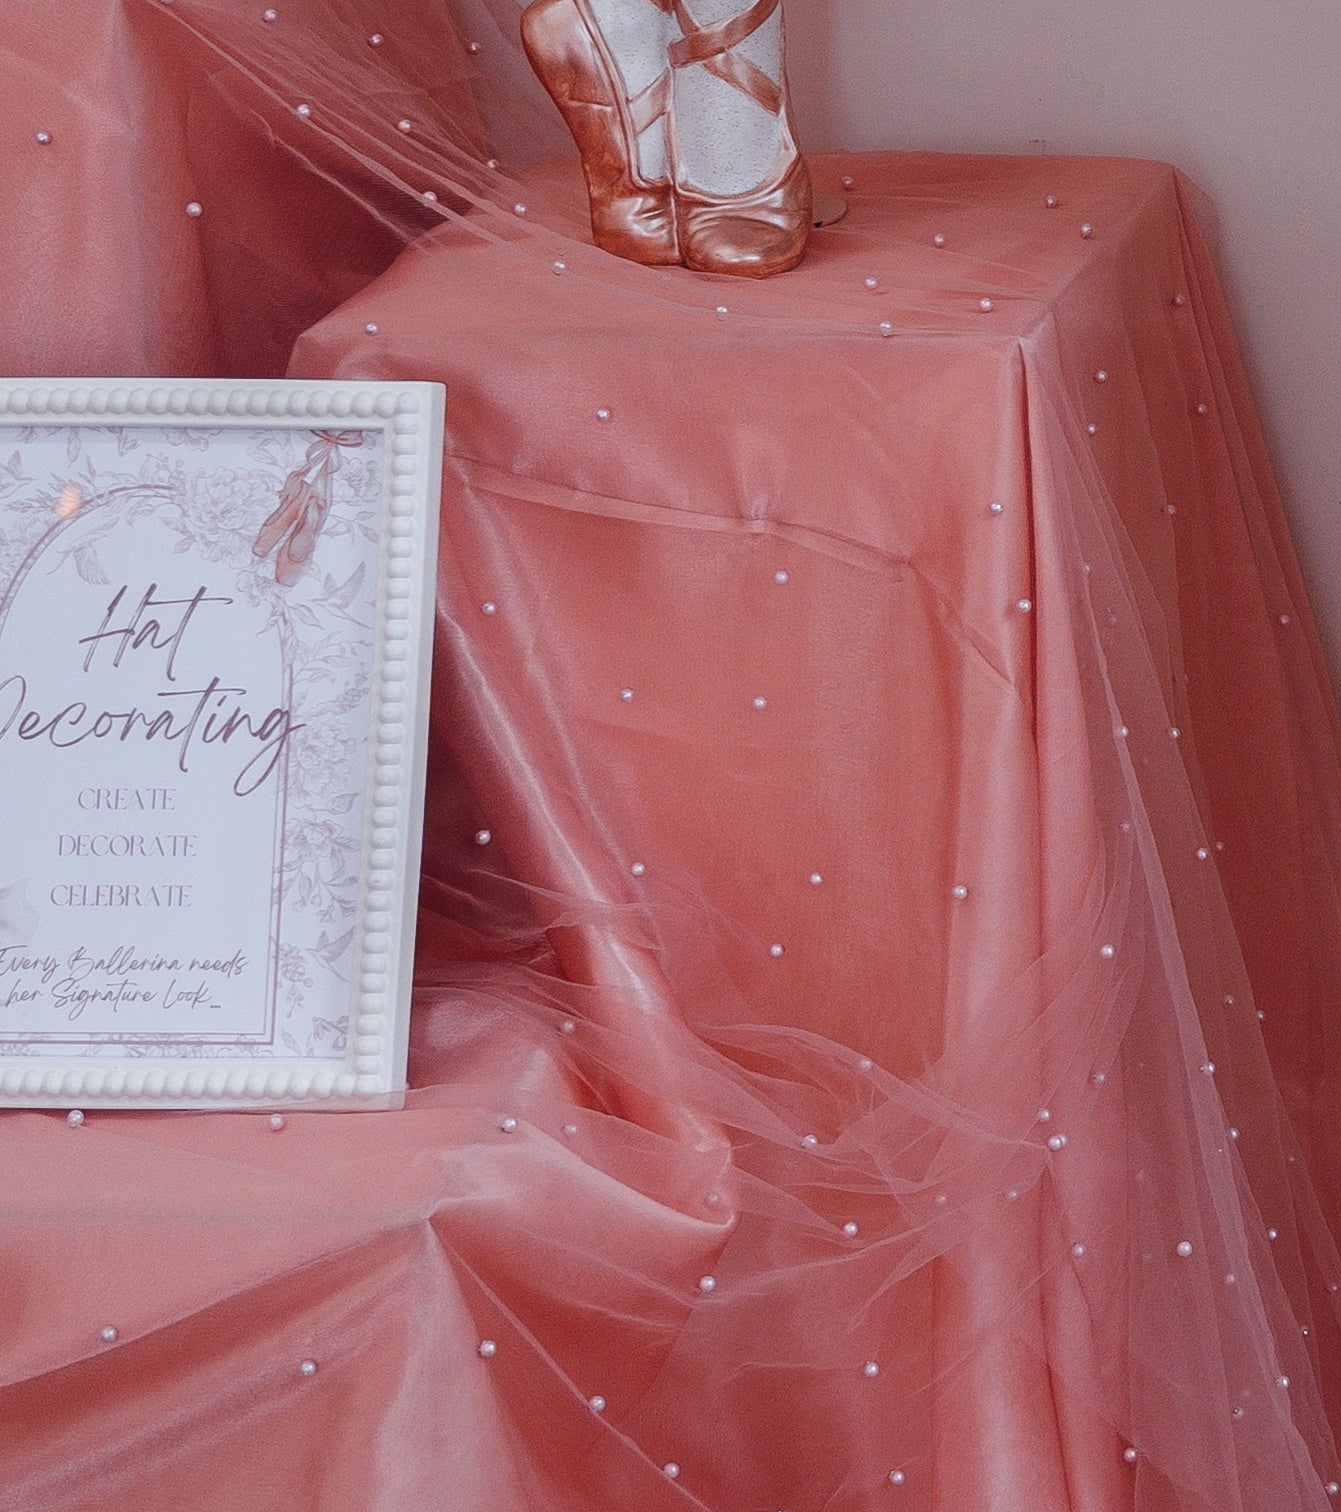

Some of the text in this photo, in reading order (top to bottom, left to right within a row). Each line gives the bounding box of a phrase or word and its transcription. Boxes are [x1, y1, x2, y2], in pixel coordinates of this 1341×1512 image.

[79, 582, 234, 681] Hat
[77, 787, 177, 810] CREATE
[57, 834, 198, 857] DECORATE
[50, 884, 193, 907] CELEBRATE
[68, 946, 183, 980] Ballerina
[189, 949, 248, 978] needs
[5, 979, 41, 1008] her
[51, 978, 158, 1021] Signature
